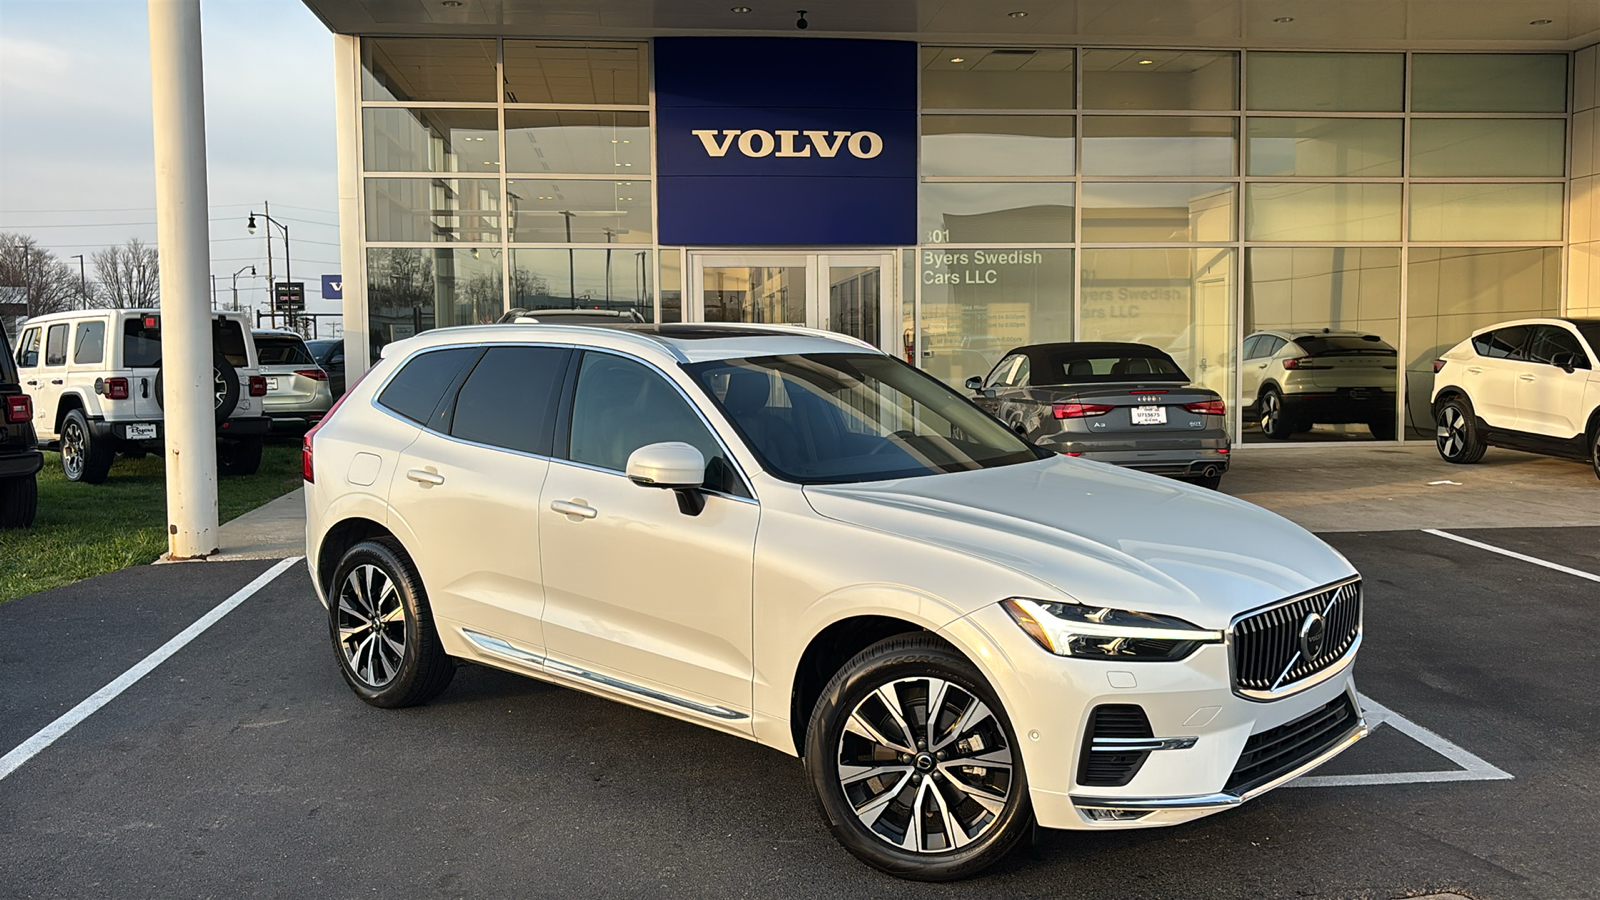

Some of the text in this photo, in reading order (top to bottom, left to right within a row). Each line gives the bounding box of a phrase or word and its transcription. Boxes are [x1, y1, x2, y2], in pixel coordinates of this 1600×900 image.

[692, 129, 883, 159] VOLVO
[924, 229, 949, 243] 301
[924, 250, 1042, 269] Byers Swedish
[923, 269, 998, 285] Cars LLC
